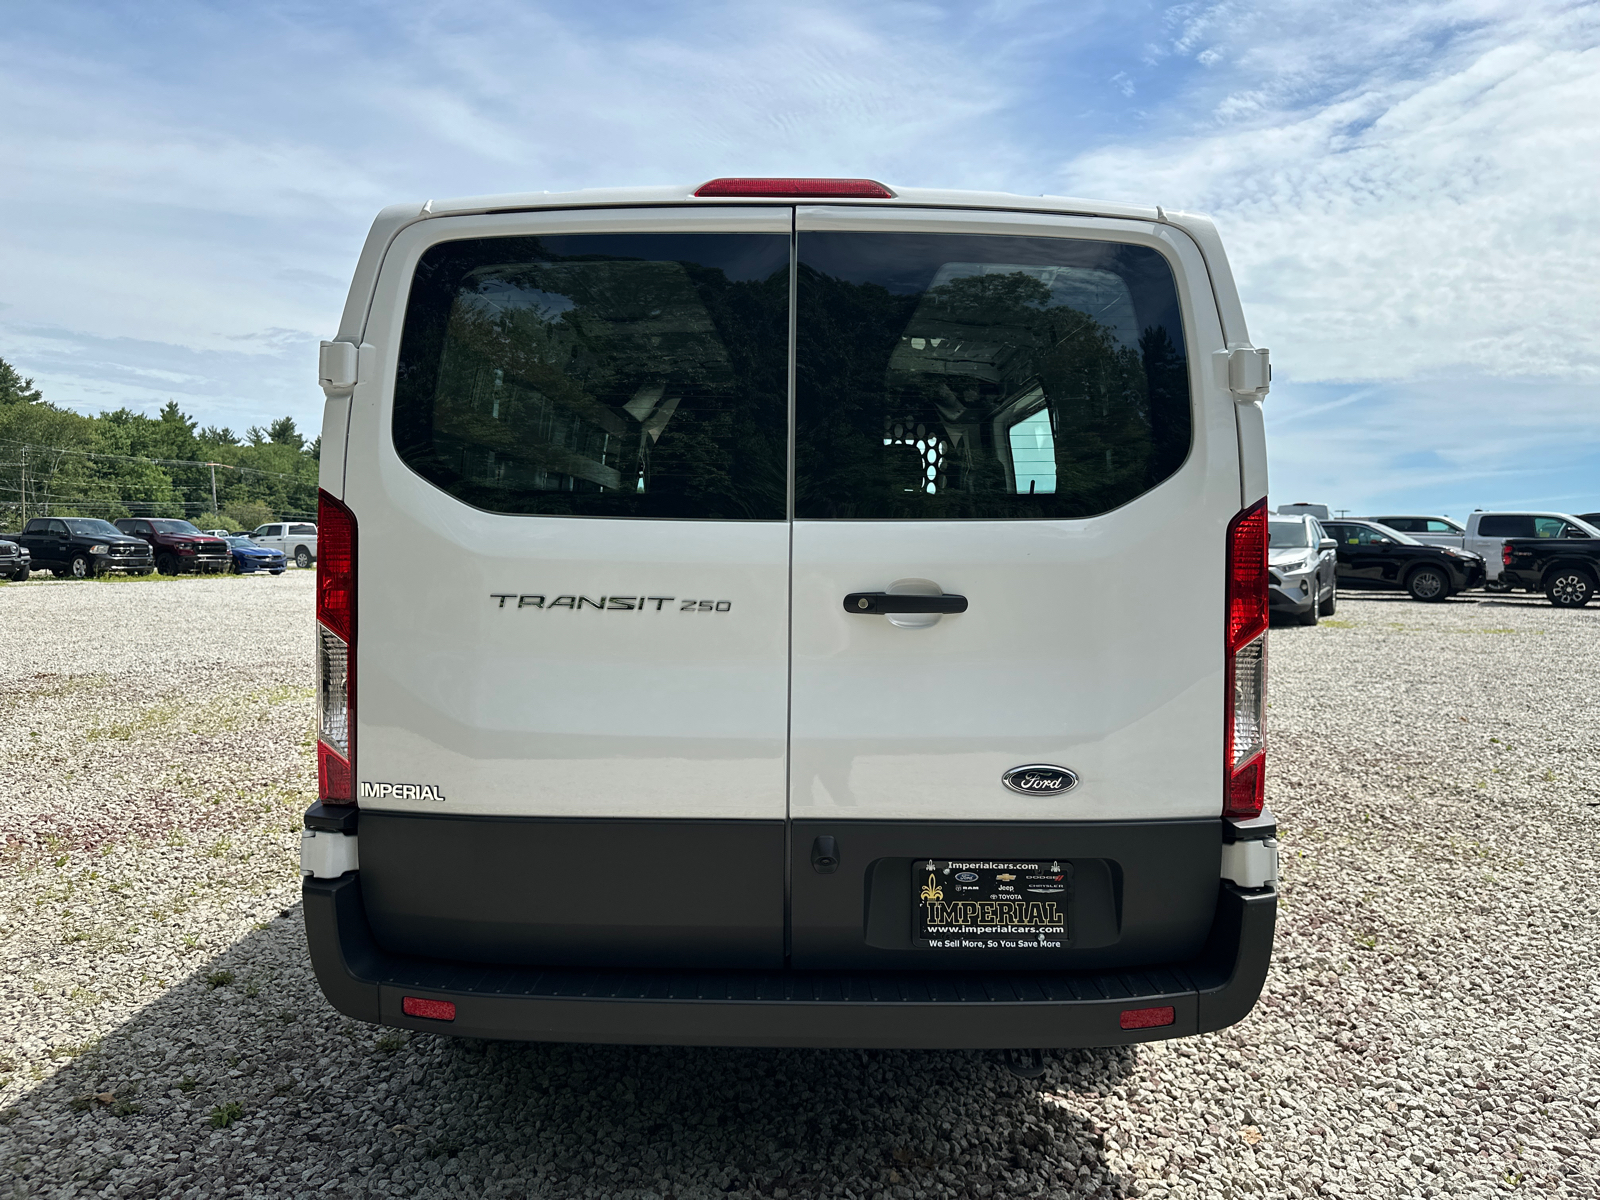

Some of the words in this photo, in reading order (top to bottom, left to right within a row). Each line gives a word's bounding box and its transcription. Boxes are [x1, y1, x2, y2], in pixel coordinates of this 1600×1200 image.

[490, 593, 676, 611] TRANSIT
[680, 600, 732, 612] 250
[1020, 771, 1063, 789] Ford
[360, 782, 446, 802] IMPERIAL
[948, 861, 1039, 870] Imperialcars.com
[998, 884, 1014, 892] Jeep
[927, 901, 1064, 926] IMPERIAL
[927, 925, 1064, 934] www.imperialcars.com
[929, 940, 942, 948] We
[944, 940, 960, 948] Sell
[962, 940, 985, 949] More,
[987, 940, 998, 948] So
[1000, 940, 1016, 948] You
[1018, 940, 1038, 948] Save
[1040, 940, 1061, 948] More
